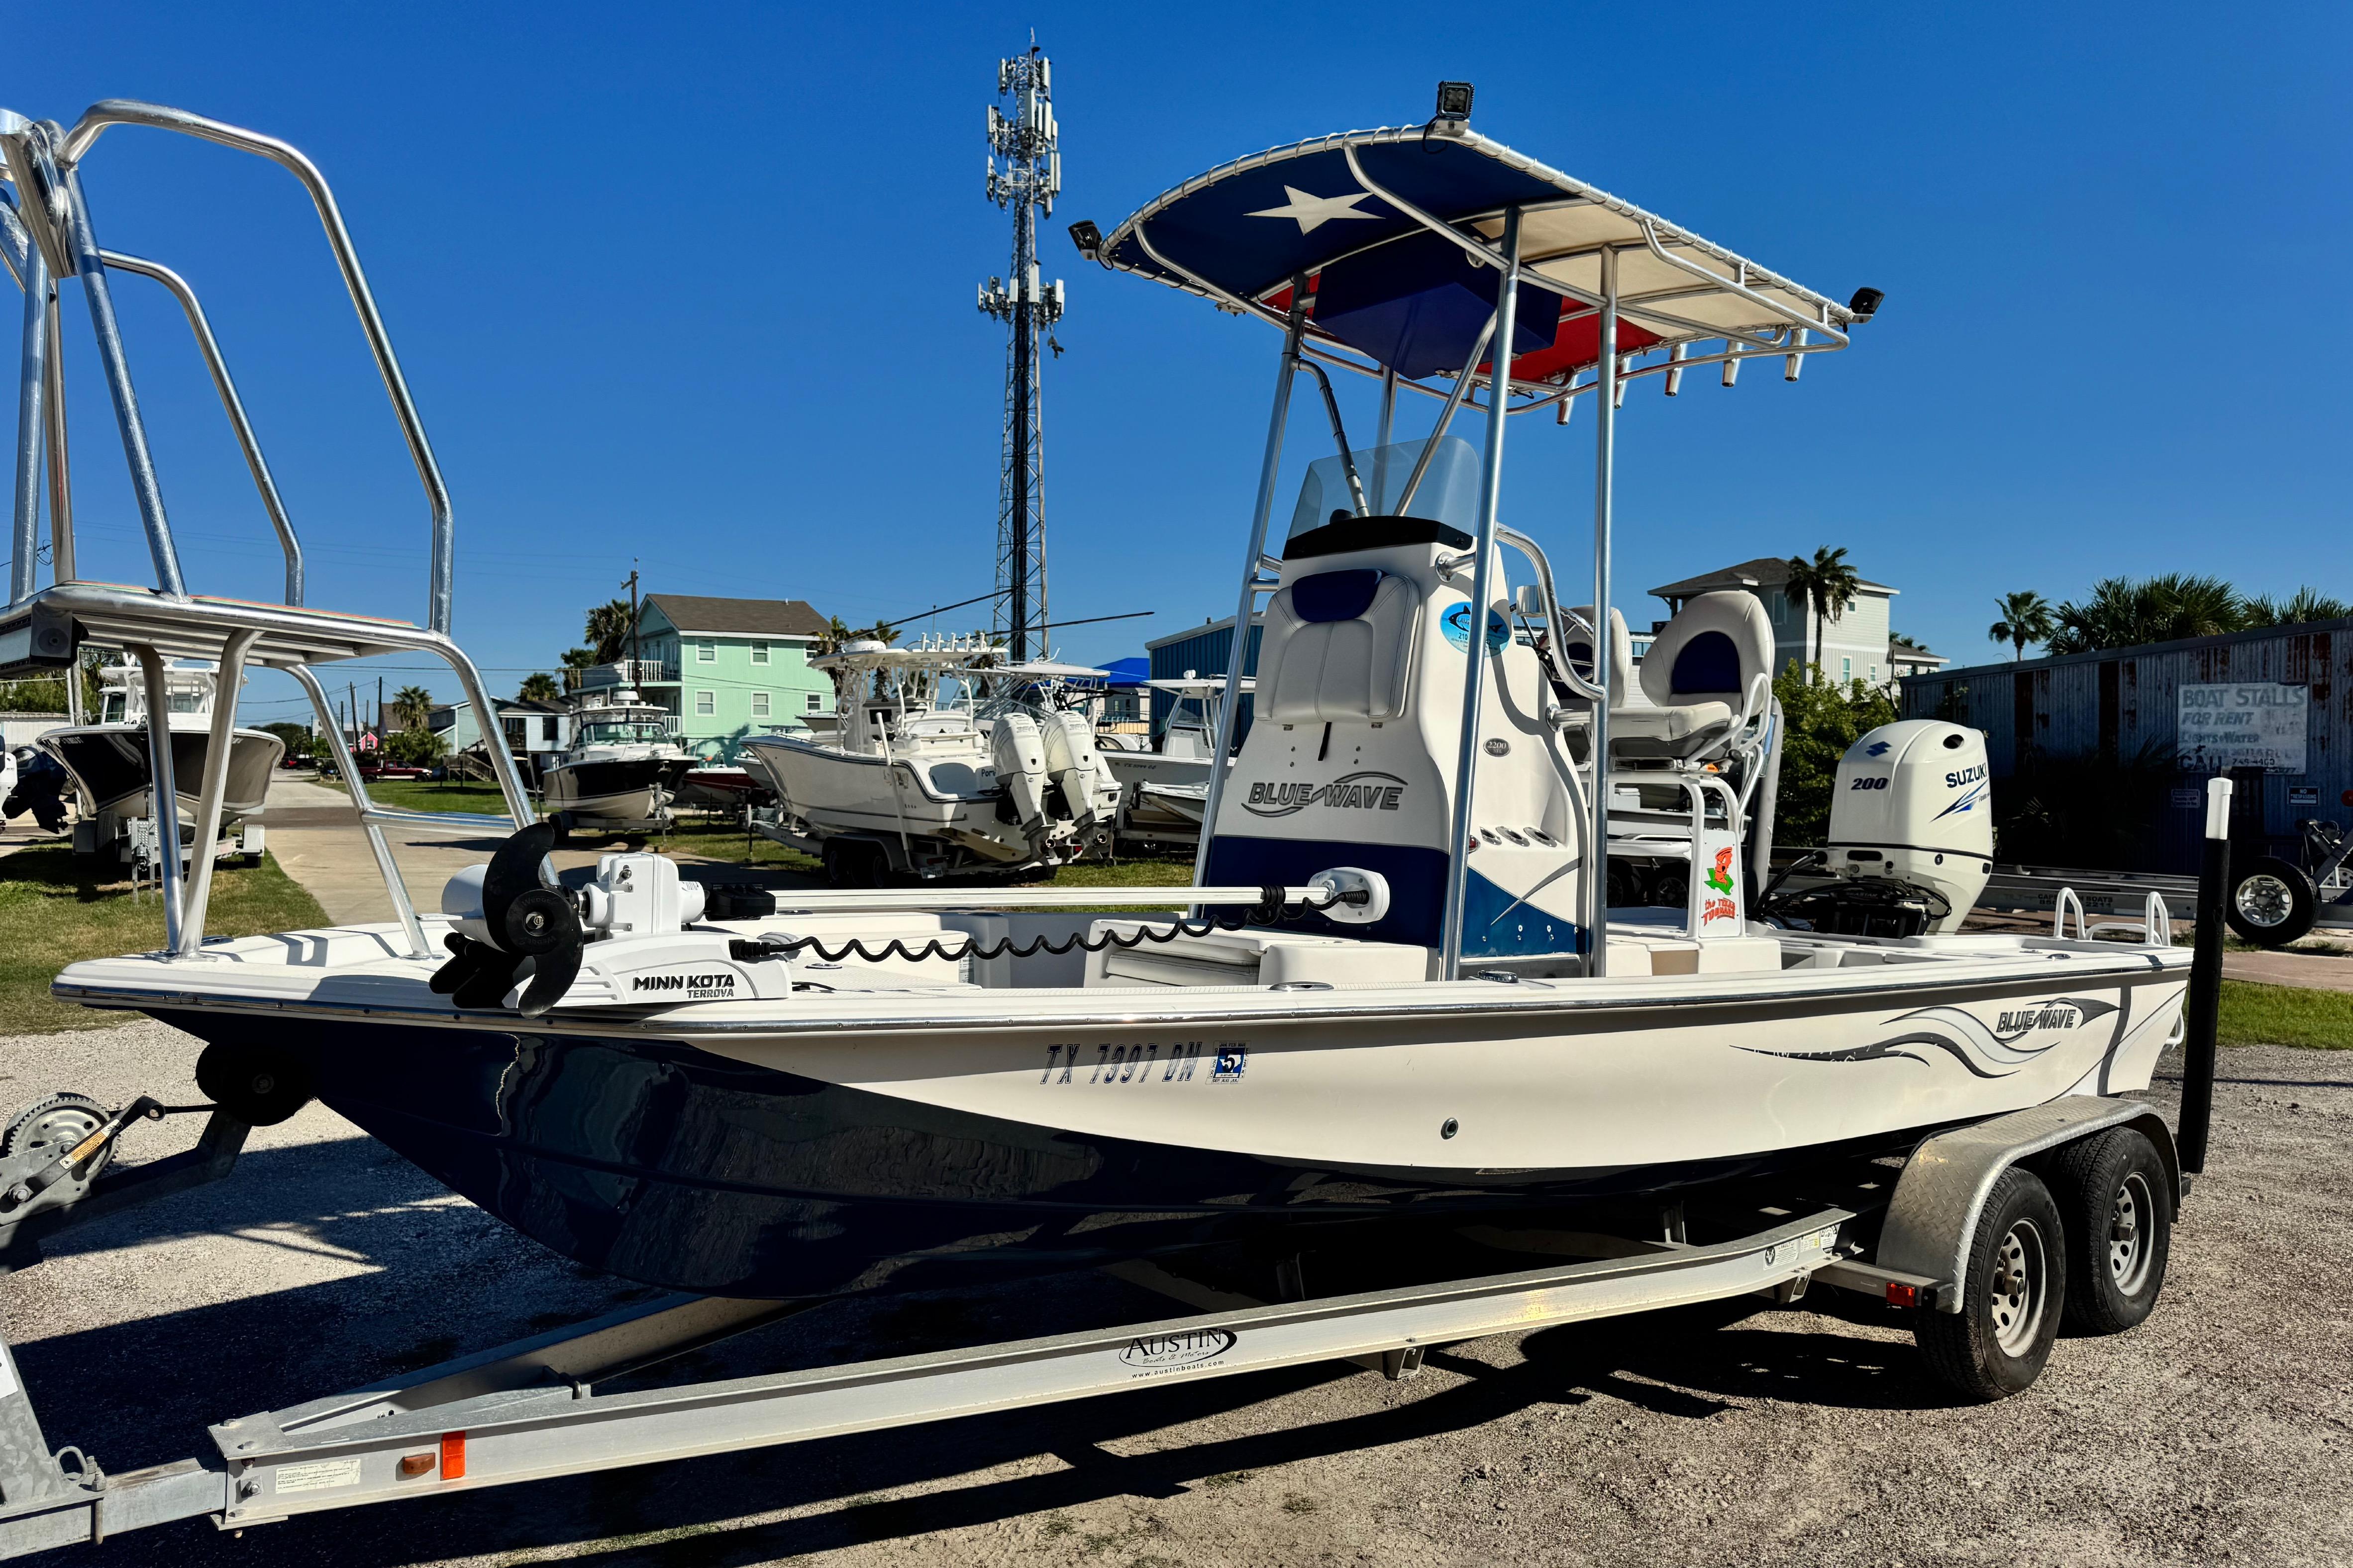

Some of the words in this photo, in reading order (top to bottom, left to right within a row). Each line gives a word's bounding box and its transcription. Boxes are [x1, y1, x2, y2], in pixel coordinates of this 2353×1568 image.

[2182, 688, 2227, 708] BOAT
[2236, 687, 2305, 707] STALLS
[2181, 712, 2211, 726] FOR
[2214, 711, 2254, 725] RENT
[1850, 777, 1889, 790] 200
[1945, 762, 1988, 788] SUZUKI
[1248, 782, 1314, 806] BLUE
[1324, 784, 1404, 811] WAVE
[632, 976, 684, 991] MINN
[686, 974, 735, 989] KOTA
[686, 988, 734, 999] TERROVA
[1996, 1010, 2036, 1033] BLUE
[2039, 1009, 2077, 1030] WAVE
[1040, 1044, 1080, 1084] TX
[1090, 1043, 1158, 1084] 7397
[1162, 1042, 1202, 1082] DN
[1223, 1048, 1235, 1073] 5
[1125, 1329, 1222, 1359] AUSTIN
[1132, 1360, 1225, 1378] www.austinboats.com
